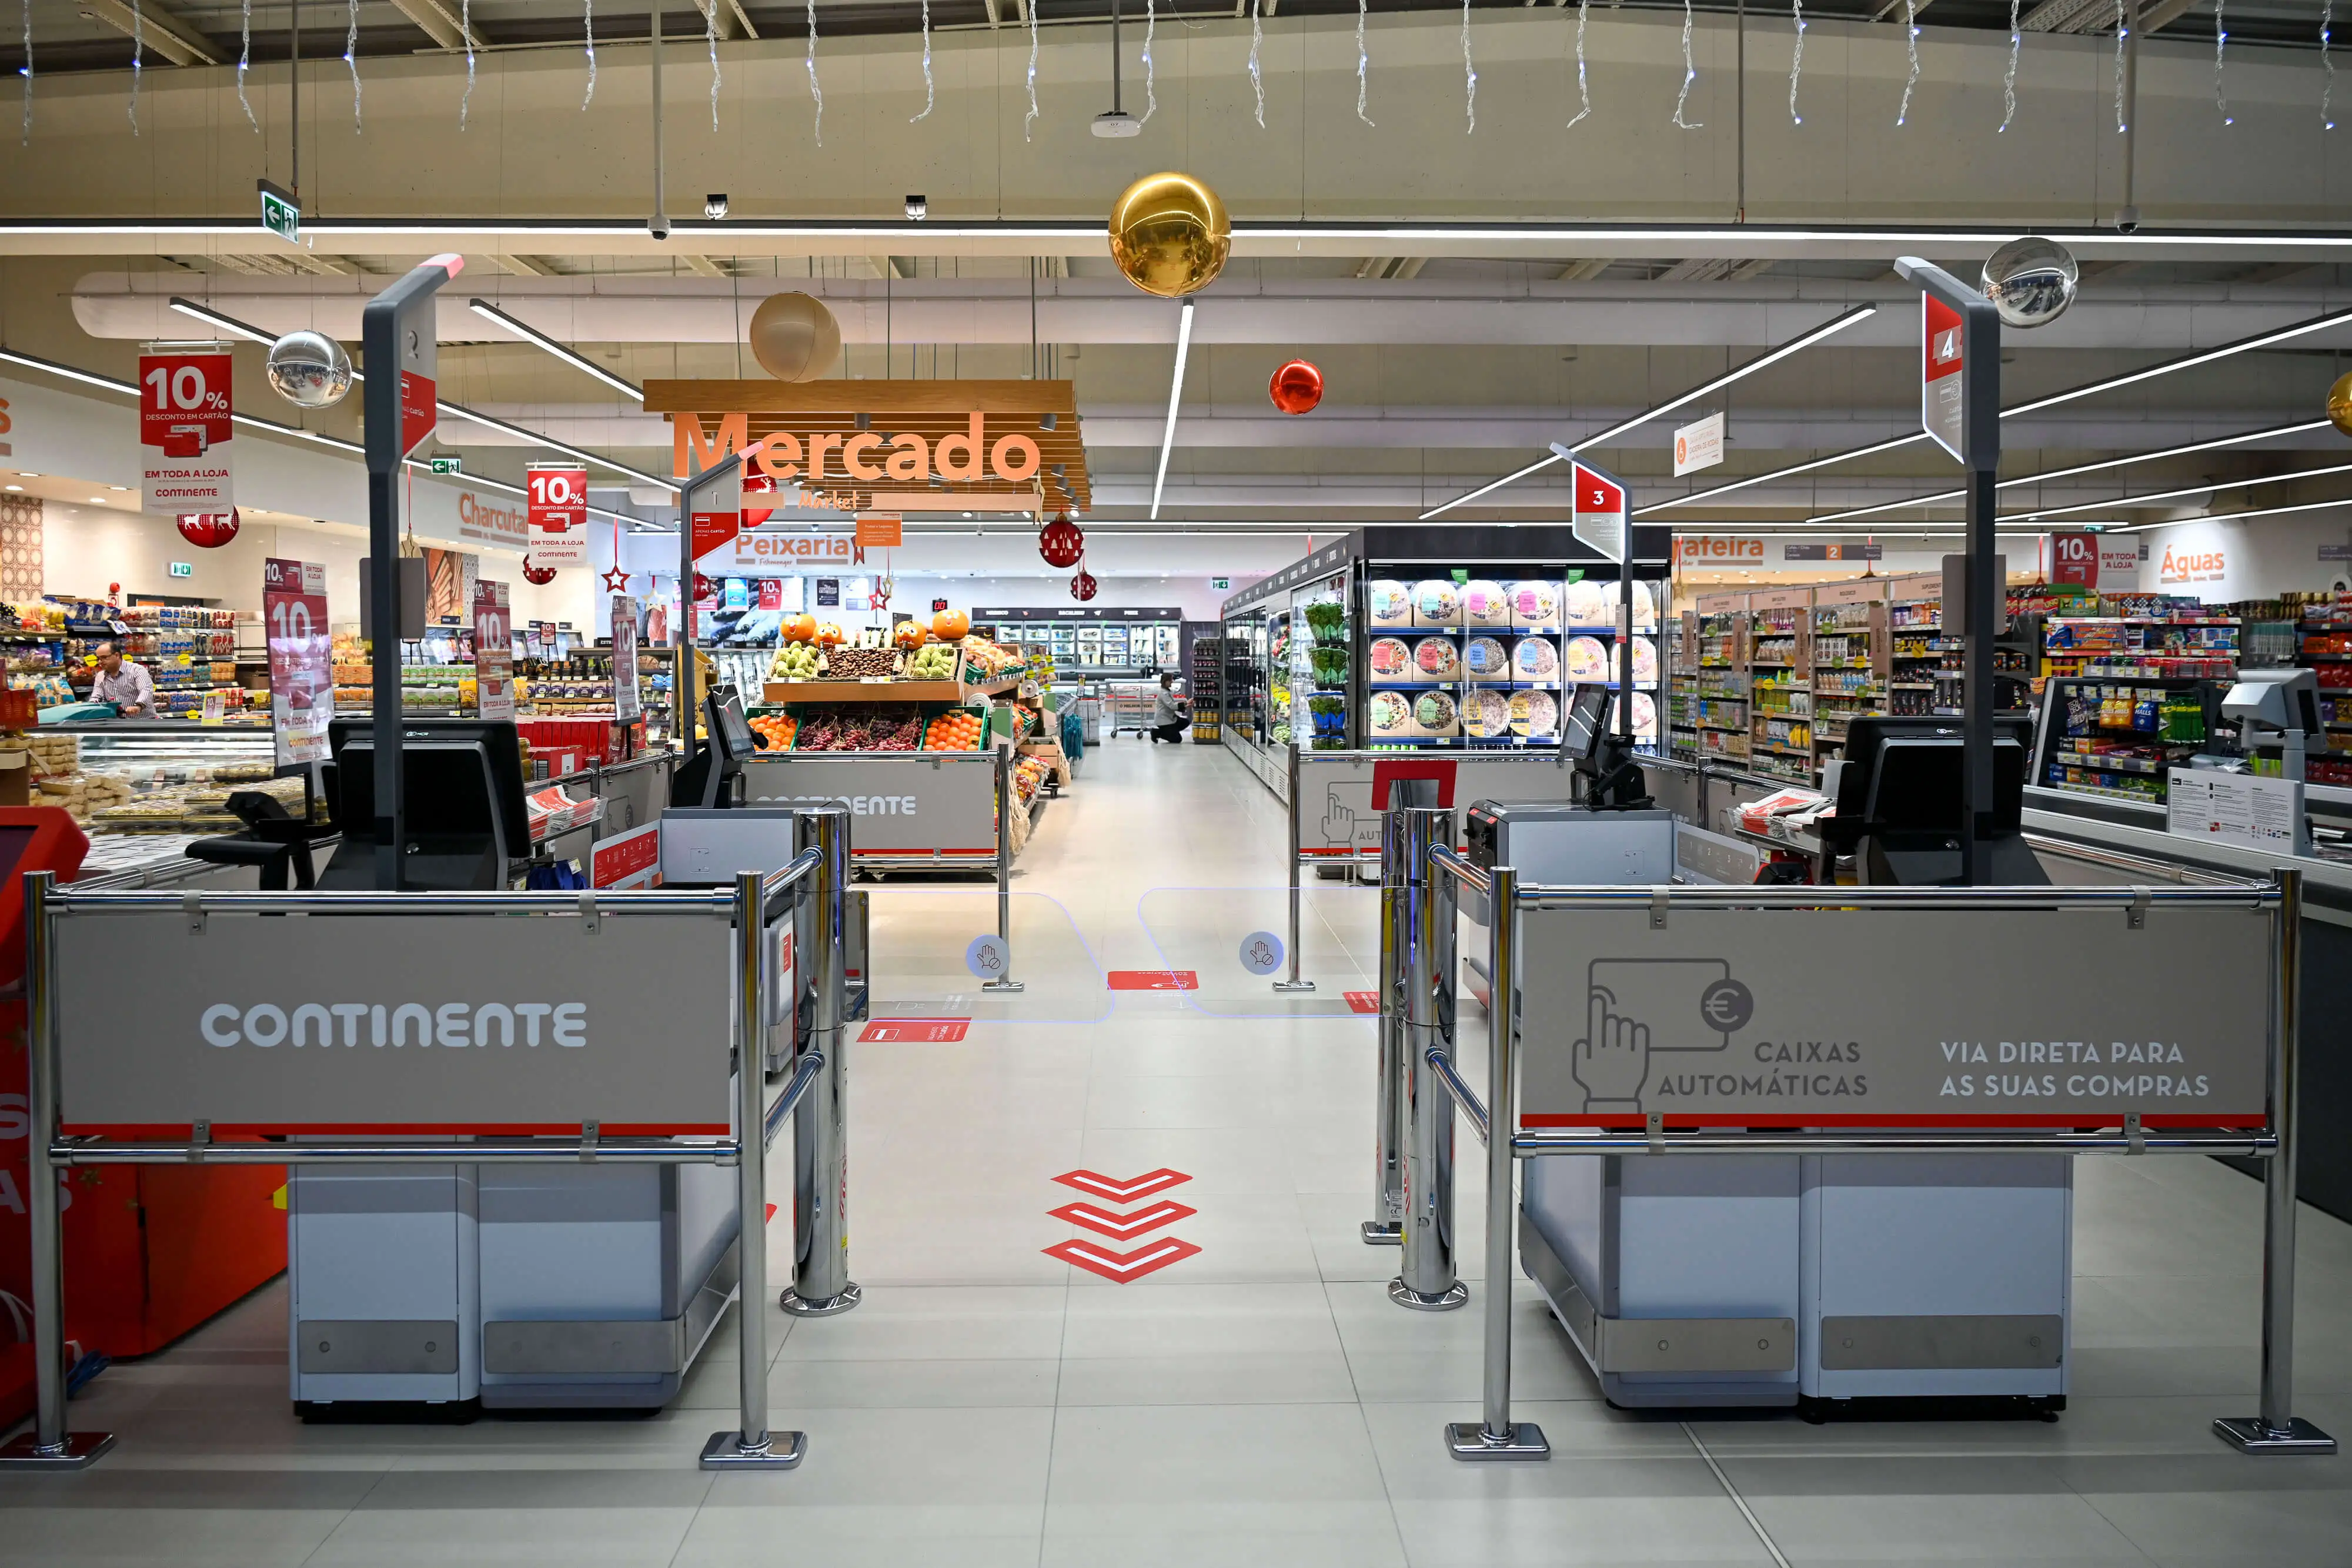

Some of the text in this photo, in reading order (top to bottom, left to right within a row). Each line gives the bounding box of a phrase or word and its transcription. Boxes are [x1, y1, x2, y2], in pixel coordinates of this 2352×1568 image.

[408, 330, 418, 359] 2
[1942, 330, 1954, 358] 4
[146, 366, 228, 410] 10%
[672, 412, 1041, 481] Mercado
[155, 488, 218, 497] CONTINENTE
[531, 477, 584, 504] 10%
[711, 491, 717, 505] 1
[797, 490, 860, 509] Market
[1593, 490, 1604, 506] 3
[459, 493, 528, 536] Charcutar
[736, 535, 848, 555] Peixaria
[1830, 547, 1838, 558] 2
[2058, 538, 2094, 560] 10%
[266, 563, 283, 582] 10%
[2161, 544, 2224, 579] Águas
[761, 581, 780, 593] 10%
[934, 601, 946, 610] 00
[479, 612, 509, 651] 10%
[201, 1002, 586, 1047] CONTINENTE
[1754, 1041, 1860, 1064] CAIXAS
[1941, 1042, 2184, 1063] VIA DIRETA PARA
[1657, 1067, 1868, 1097] AUTOMÁTICAS
[1939, 1075, 2210, 1096] AS SUAS COMPRAS
